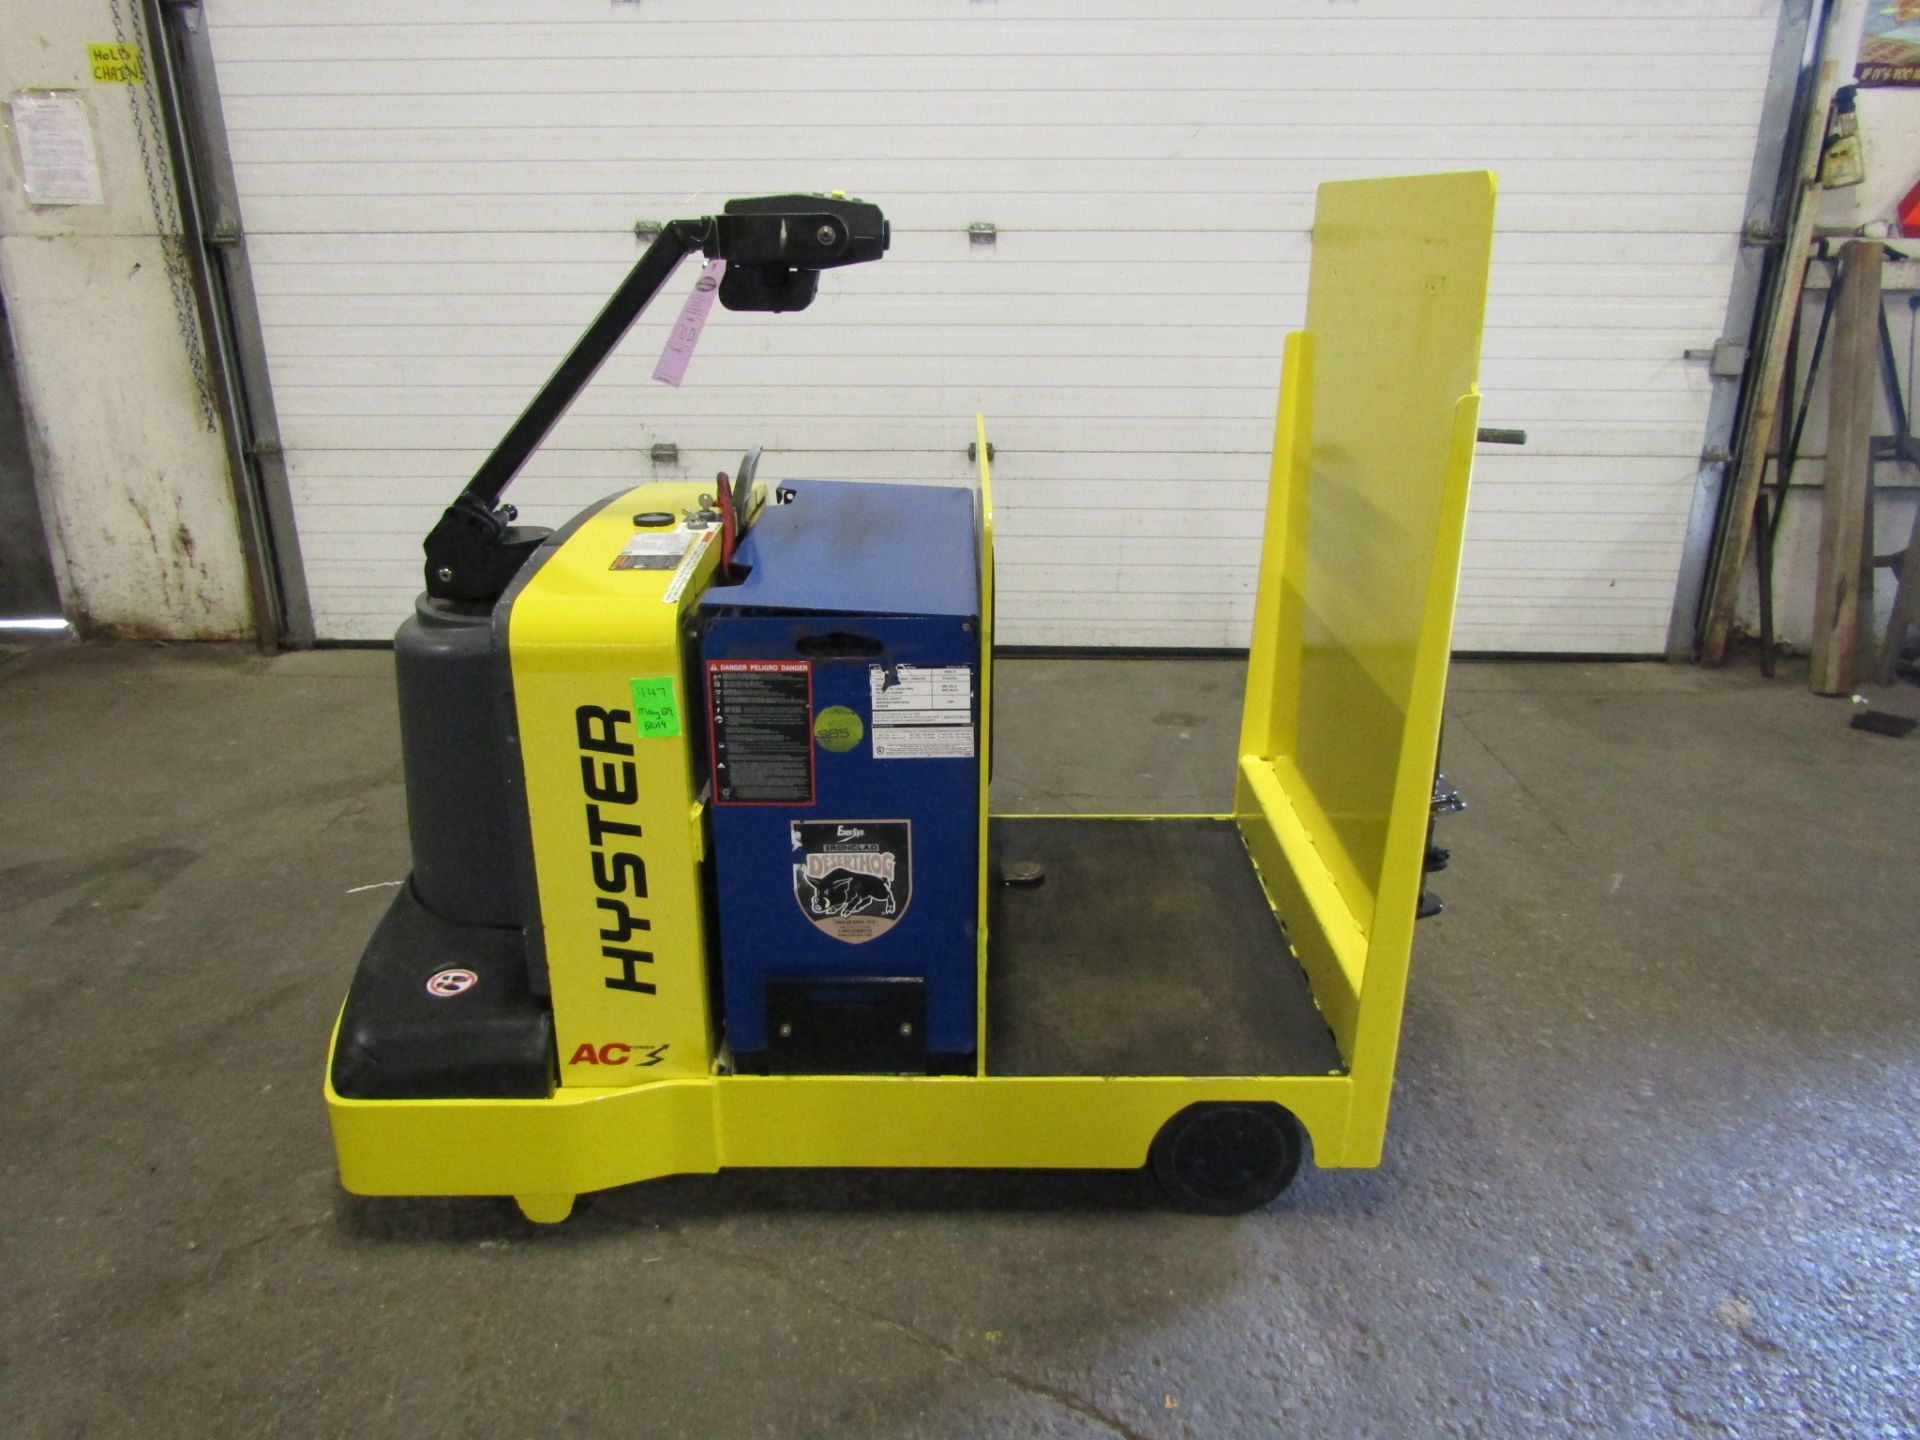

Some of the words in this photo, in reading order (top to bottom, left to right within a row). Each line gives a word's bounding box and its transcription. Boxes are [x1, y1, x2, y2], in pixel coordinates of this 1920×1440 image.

[720, 664, 748, 672] DANGER
[750, 664, 779, 672] PELIGRO
[781, 664, 808, 672] DANGER
[575, 705, 657, 995] HYSTER
[807, 852, 896, 881] DESERTHOG
[568, 1042, 631, 1065] AC
